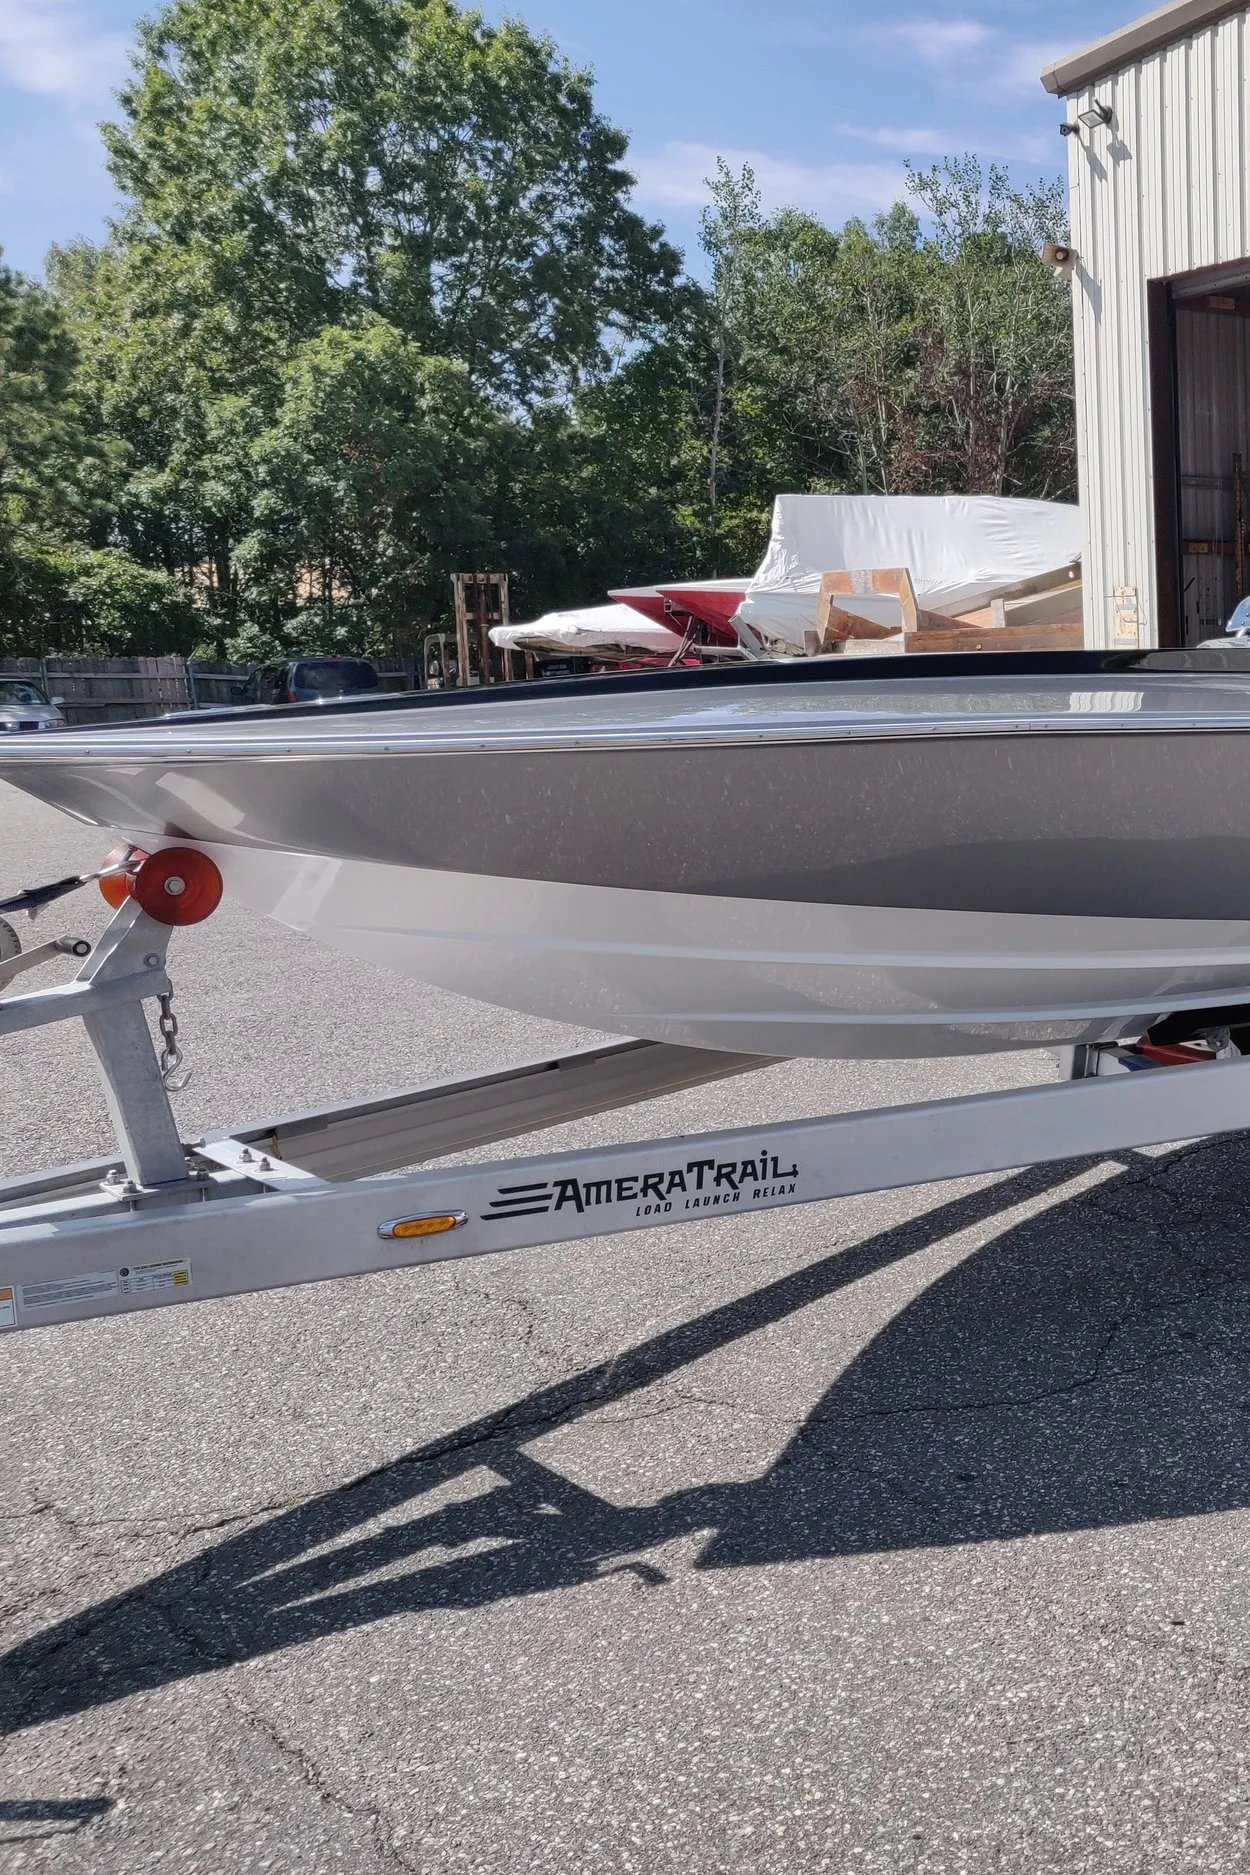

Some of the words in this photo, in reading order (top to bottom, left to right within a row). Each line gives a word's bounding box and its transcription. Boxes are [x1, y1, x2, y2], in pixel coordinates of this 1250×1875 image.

[635, 1201, 673, 1217] LOAD
[684, 1191, 741, 1210] LAUNCH
[752, 1182, 798, 1200] RELAX
